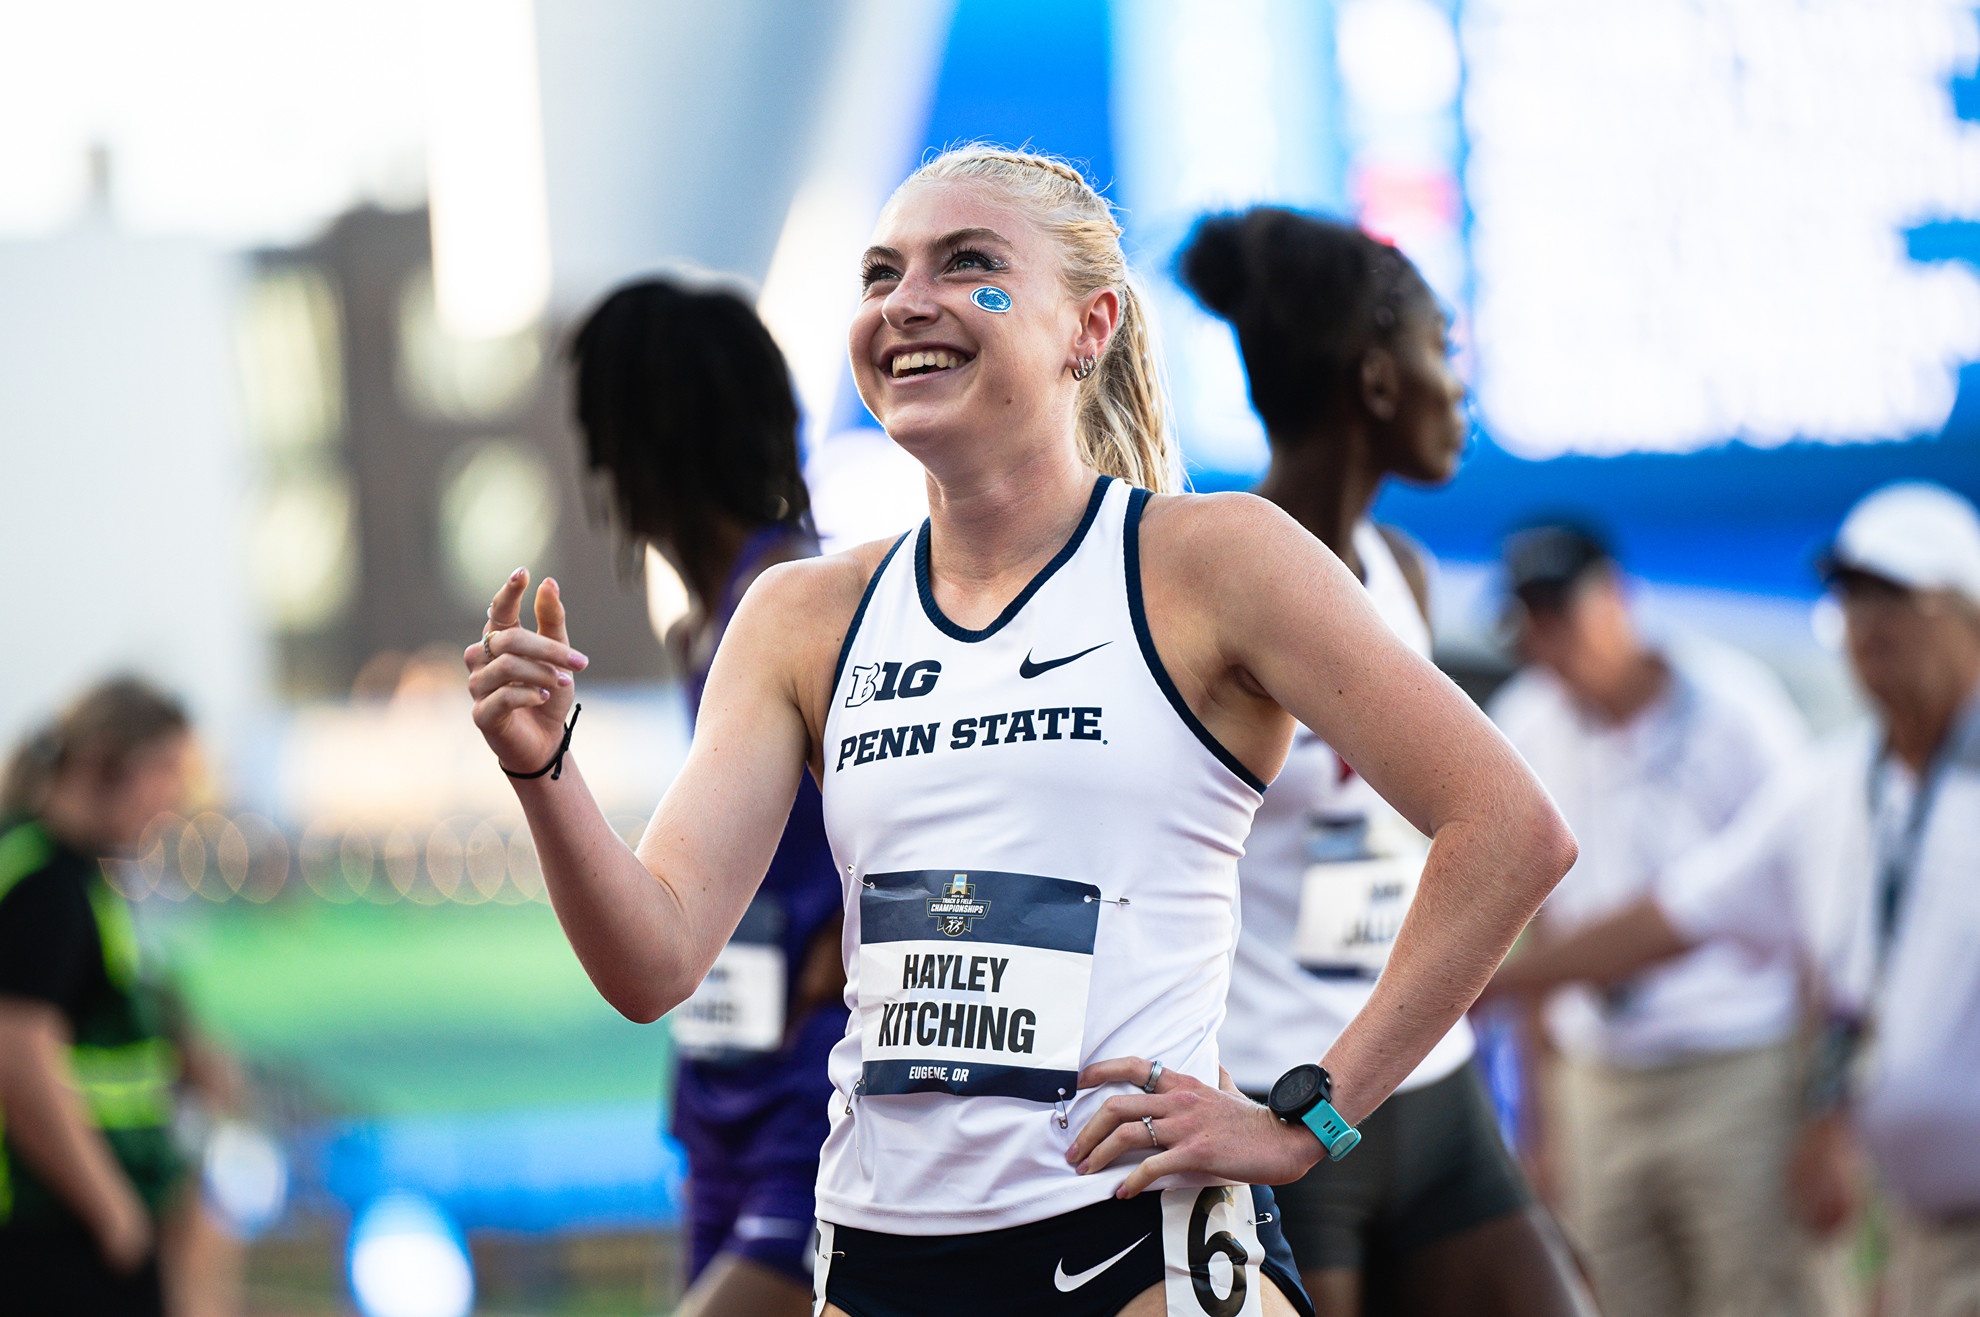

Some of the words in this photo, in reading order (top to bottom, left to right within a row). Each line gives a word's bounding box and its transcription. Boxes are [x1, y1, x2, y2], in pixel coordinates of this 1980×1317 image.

[836, 722, 940, 773] PENN
[950, 707, 1102, 750] STATE
[930, 903, 984, 914] CHAMPIONSHIPS
[902, 954, 1009, 993] HAYLEY
[878, 1001, 1037, 1054] KITCHING
[909, 1066, 949, 1082] EUGENE,
[952, 1068, 970, 1082] OR
[1188, 1186, 1248, 1317] 6
